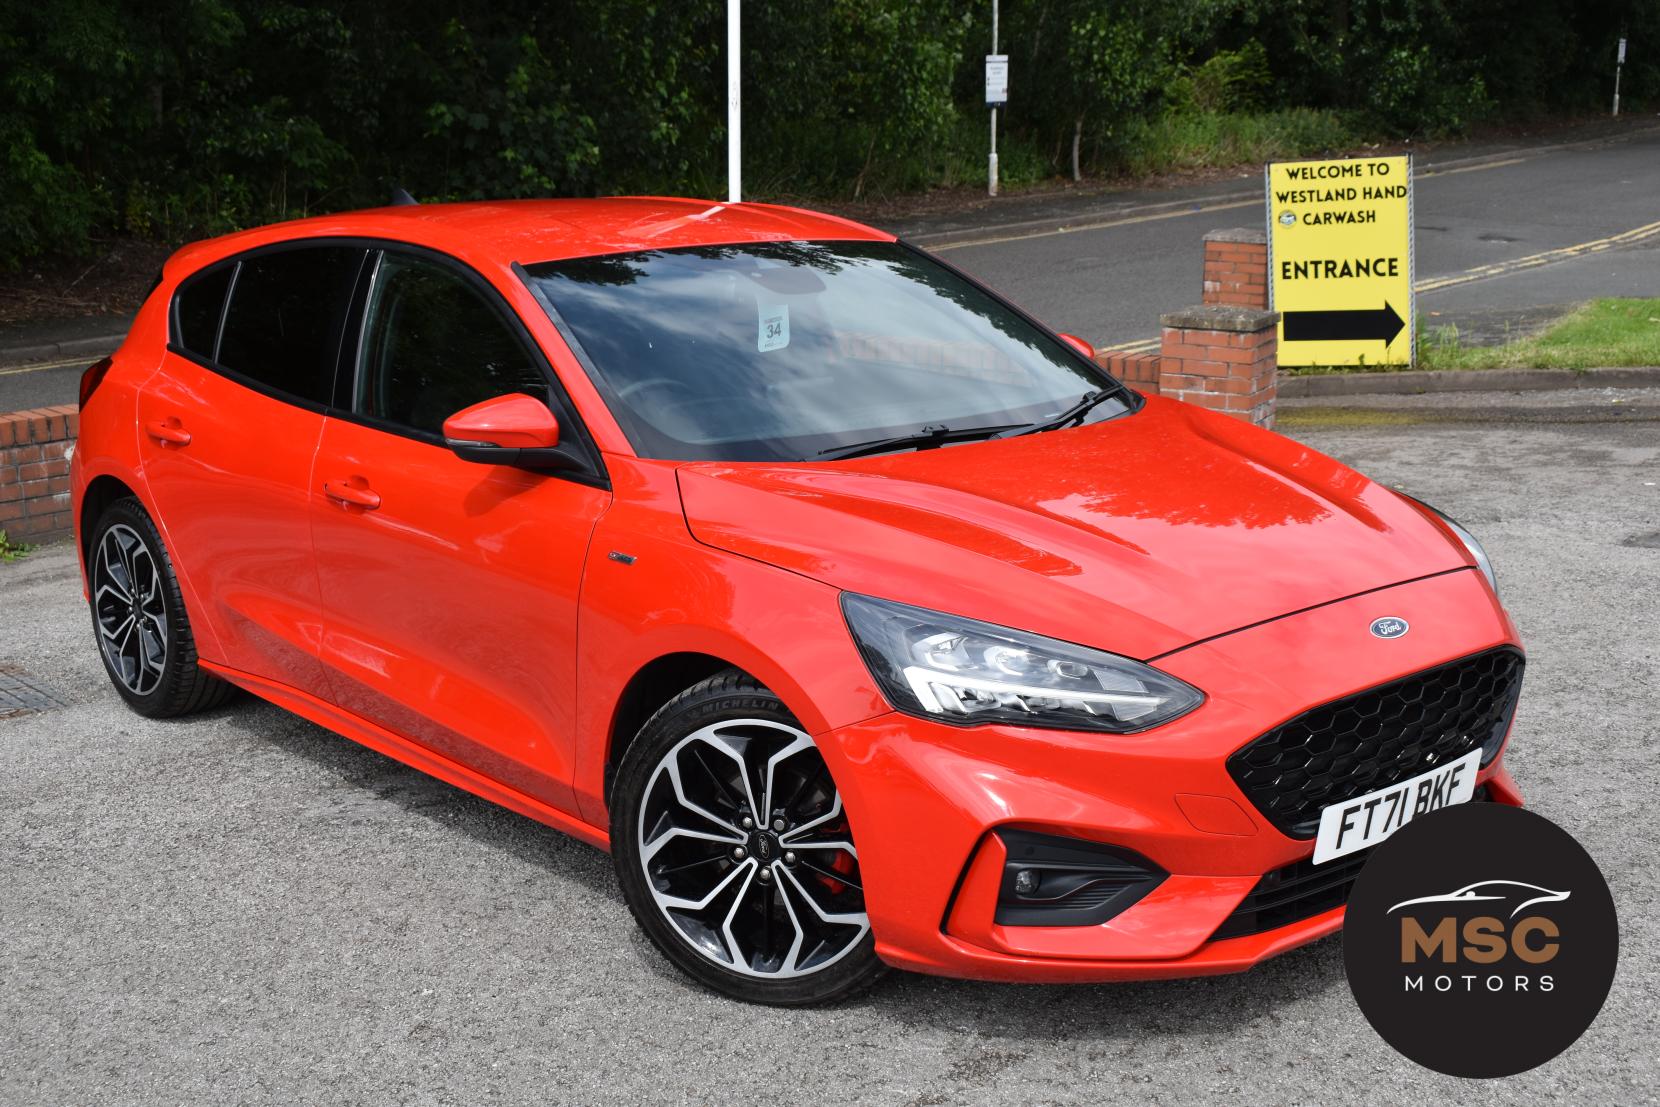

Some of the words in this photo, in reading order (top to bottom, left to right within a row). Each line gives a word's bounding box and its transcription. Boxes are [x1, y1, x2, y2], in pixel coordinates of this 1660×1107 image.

[1286, 164, 1362, 180] WELCOME
[1368, 163, 1390, 176] TO
[1276, 188, 1356, 203] WESTLAND
[1363, 186, 1407, 200] HAND
[1303, 211, 1375, 225] CARWASH
[1282, 258, 1398, 280] ENTRANCE
[766, 322, 781, 338] 34
[1379, 621, 1401, 634] Ford
[702, 699, 779, 712] MICHELIN
[1336, 787, 1409, 849] FT71
[1413, 763, 1466, 816] BKF
